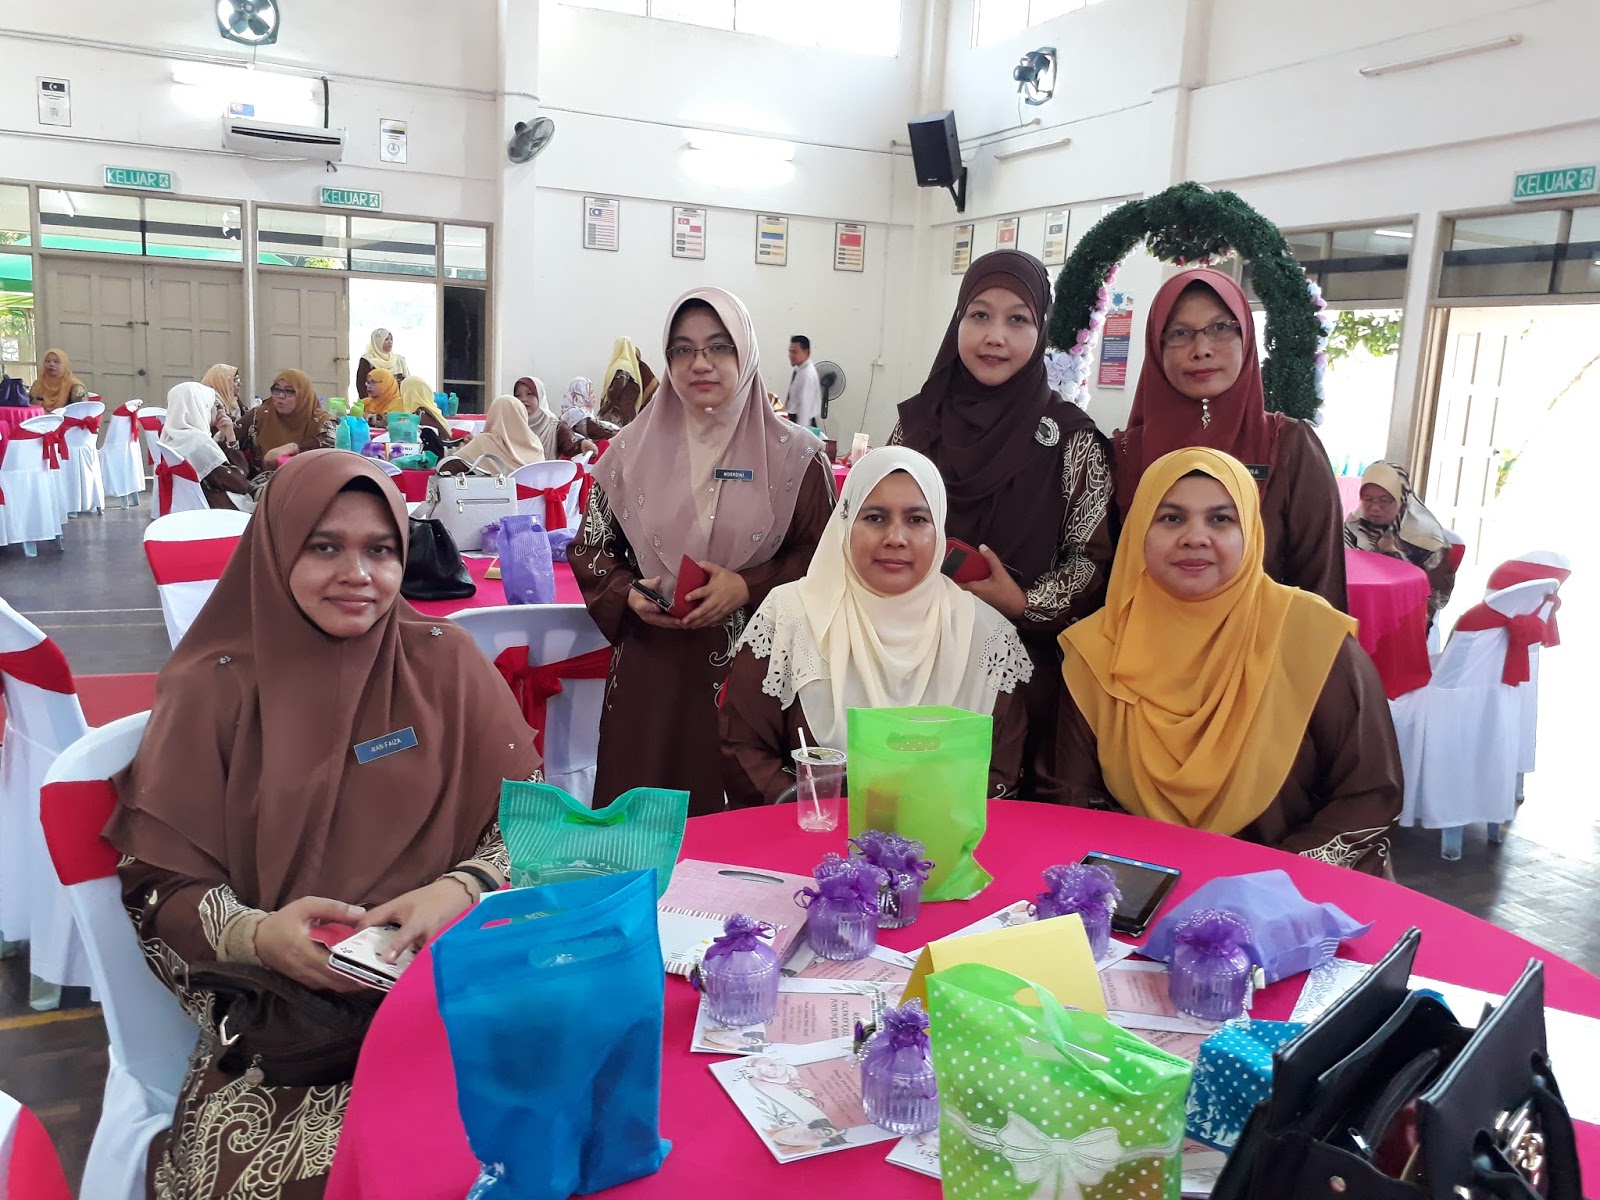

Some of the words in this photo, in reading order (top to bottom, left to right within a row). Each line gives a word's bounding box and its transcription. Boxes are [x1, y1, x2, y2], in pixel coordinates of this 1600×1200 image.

[107, 169, 157, 187] KELUAR
[1516, 170, 1577, 195] KELUAR
[324, 190, 367, 206] KELUAR
